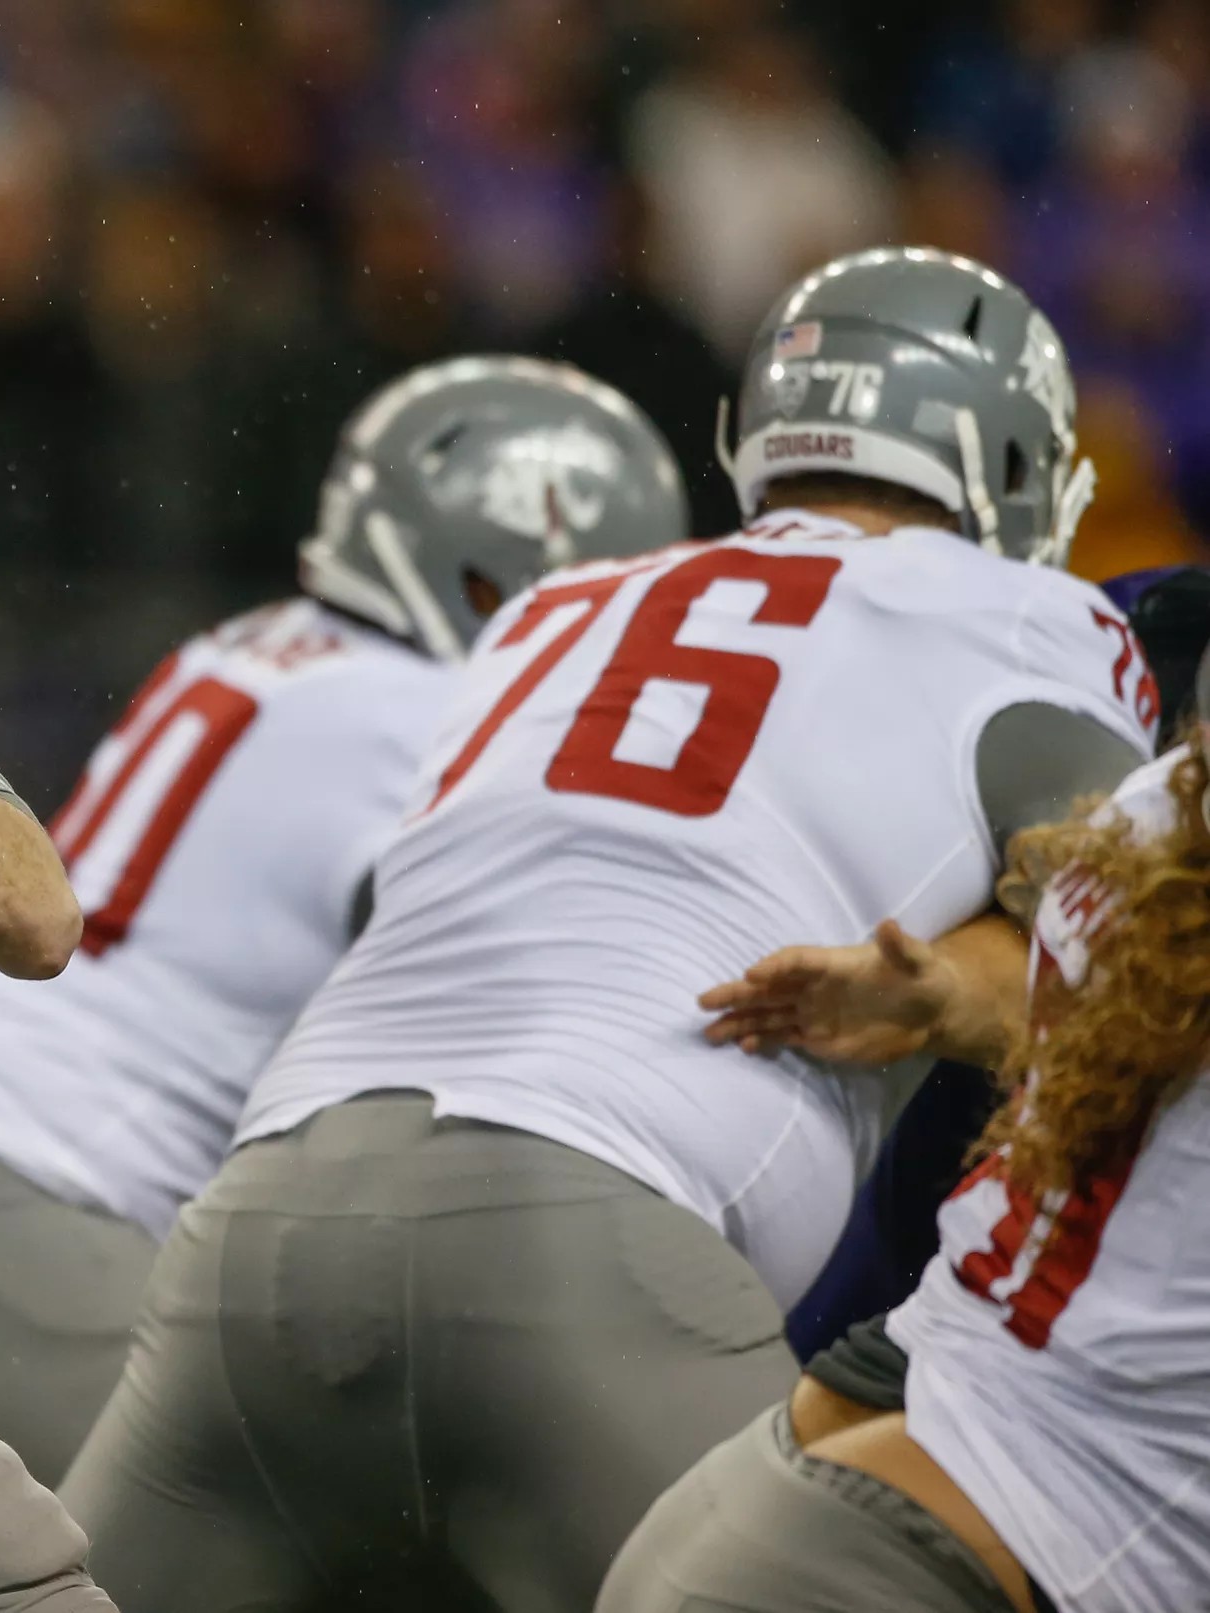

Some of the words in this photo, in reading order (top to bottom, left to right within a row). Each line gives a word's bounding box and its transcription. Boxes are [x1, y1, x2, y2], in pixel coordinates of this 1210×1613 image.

[824, 361, 885, 421] 76
[764, 433, 855, 461] COUGARS
[402, 547, 843, 820] 76
